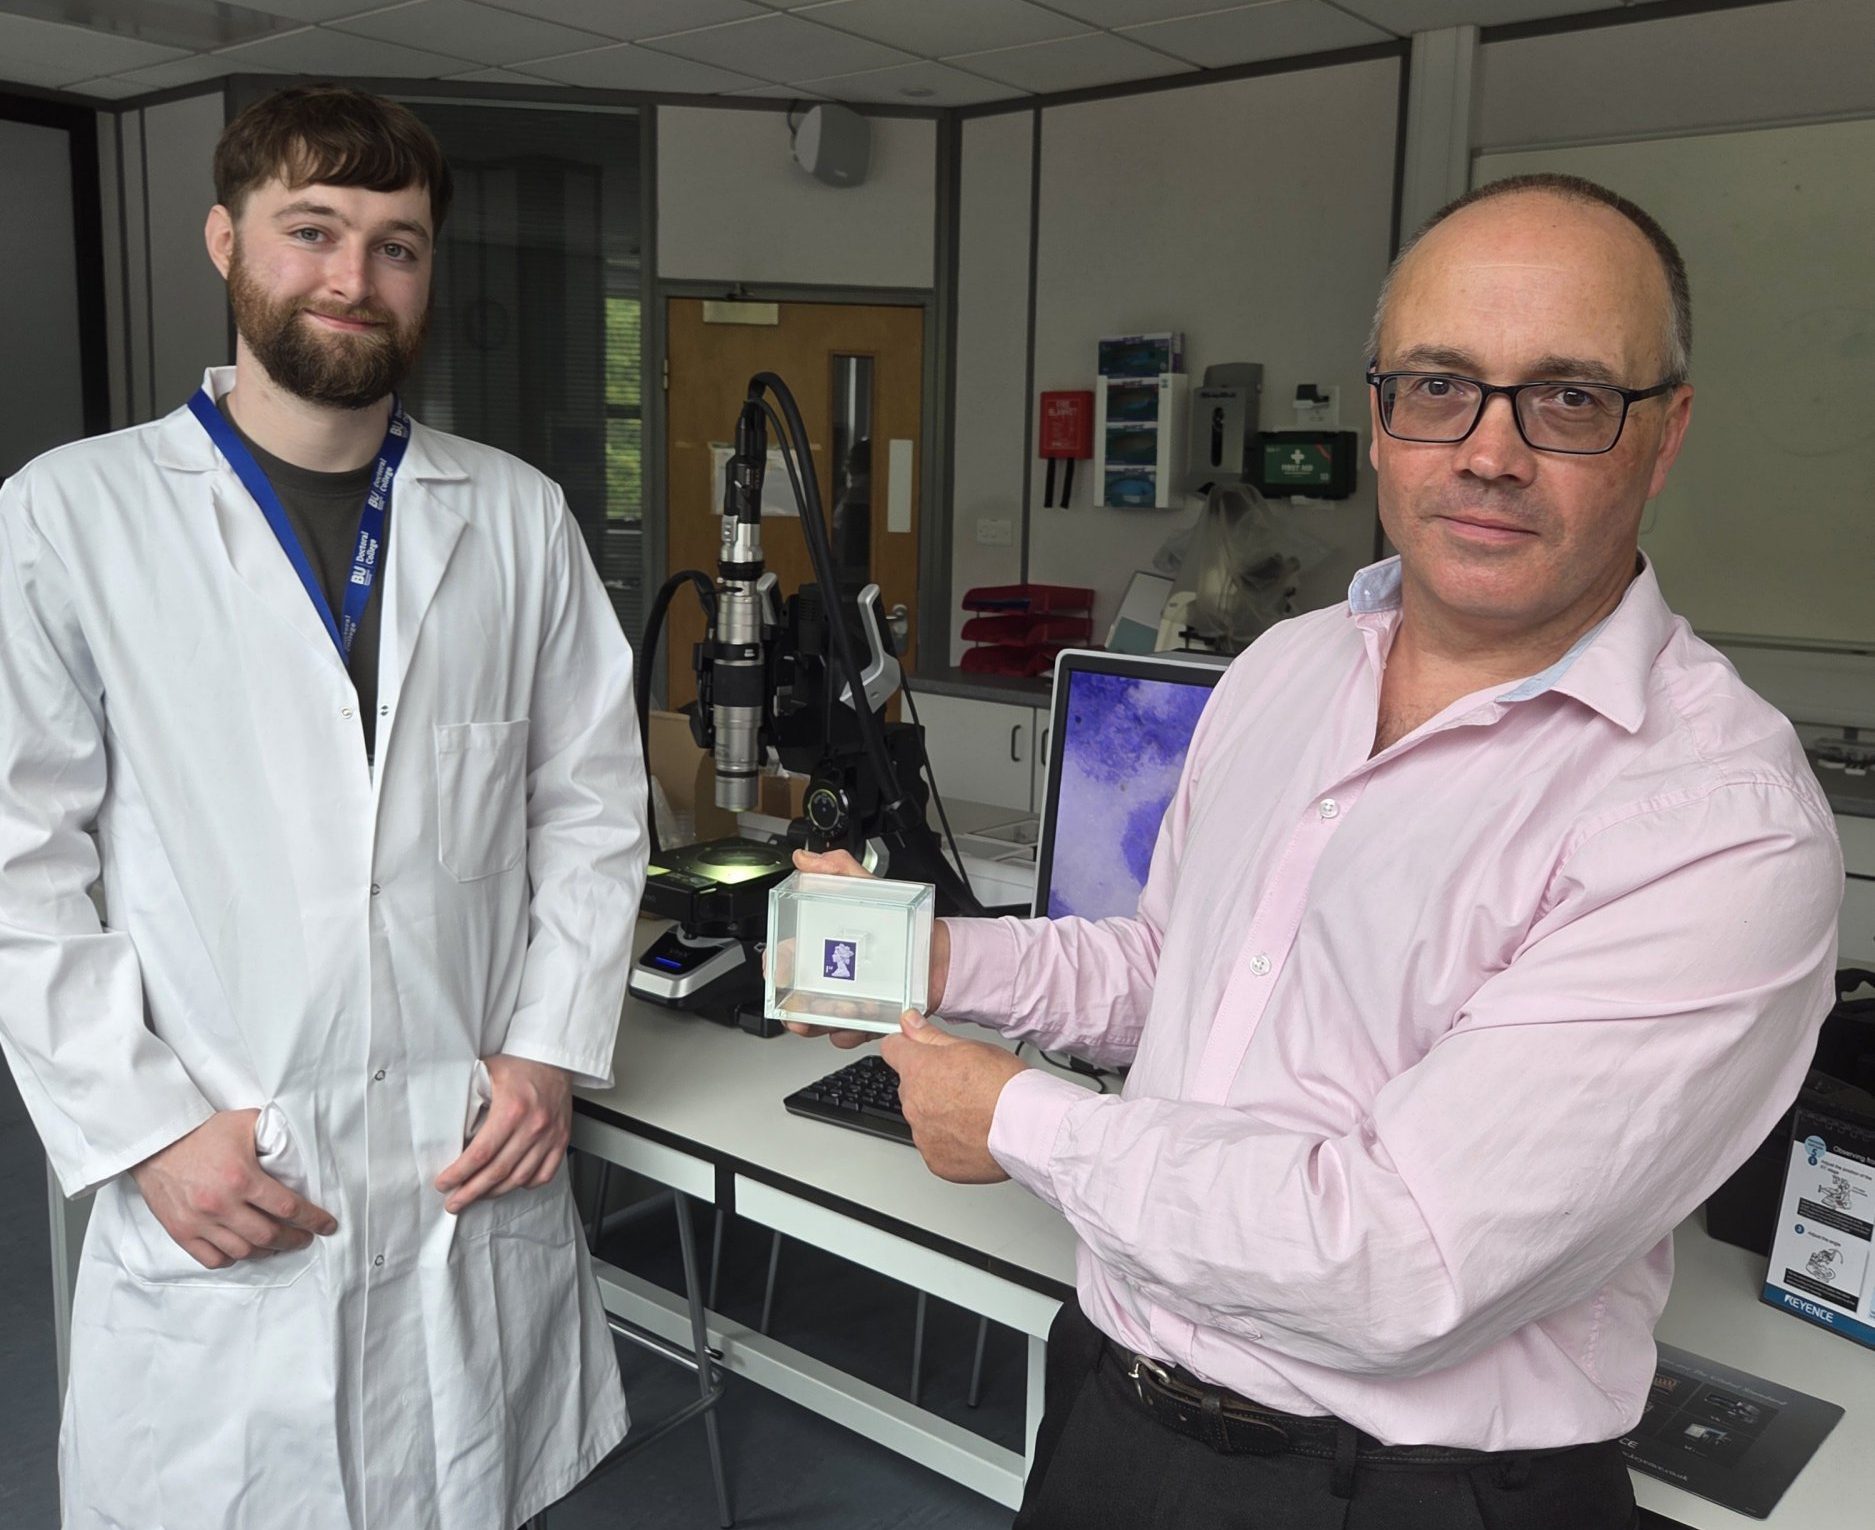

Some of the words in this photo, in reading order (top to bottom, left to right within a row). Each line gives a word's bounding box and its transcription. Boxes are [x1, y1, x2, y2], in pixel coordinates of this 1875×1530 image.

[373, 457, 388, 489] Doctoral
[379, 465, 394, 493] College
[1281, 464, 1300, 472] FIRST
[1301, 464, 1314, 472] AID
[367, 490, 382, 510] BU
[356, 530, 369, 563] Doctoral
[365, 538, 379, 565] College
[350, 565, 367, 586] BU
[1832, 1145, 1866, 1163] Observing
[1783, 1293, 1834, 1324] KEYENCE
